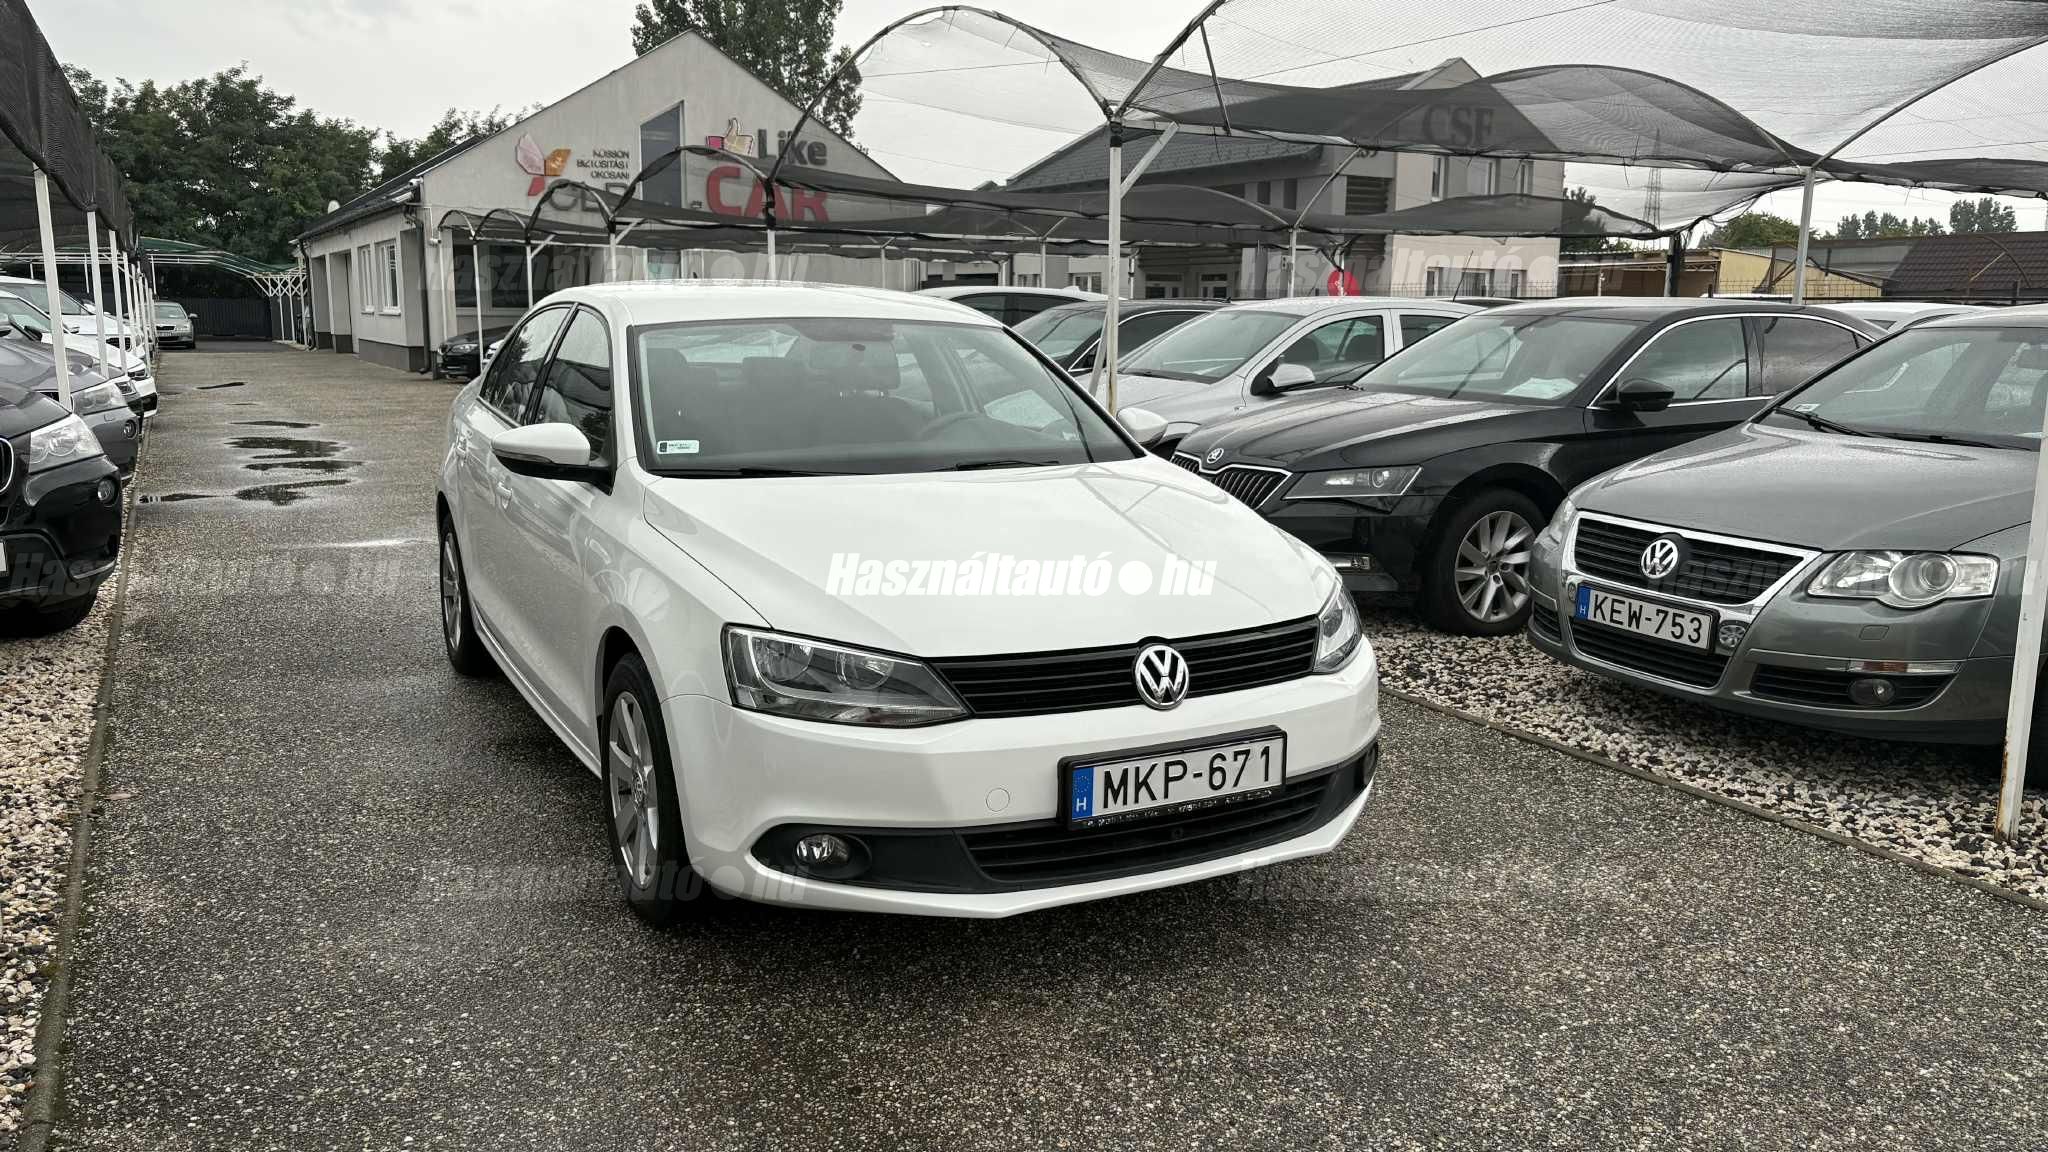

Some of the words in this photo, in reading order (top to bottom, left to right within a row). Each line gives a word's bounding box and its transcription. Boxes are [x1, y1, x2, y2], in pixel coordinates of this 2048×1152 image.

[757, 128, 828, 166] Like
[706, 166, 830, 222] CAR
[1579, 605, 1587, 615] H
[1593, 594, 1703, 644] KEW-753
[1075, 797, 1087, 812] H
[1103, 745, 1271, 809] MKP-671
